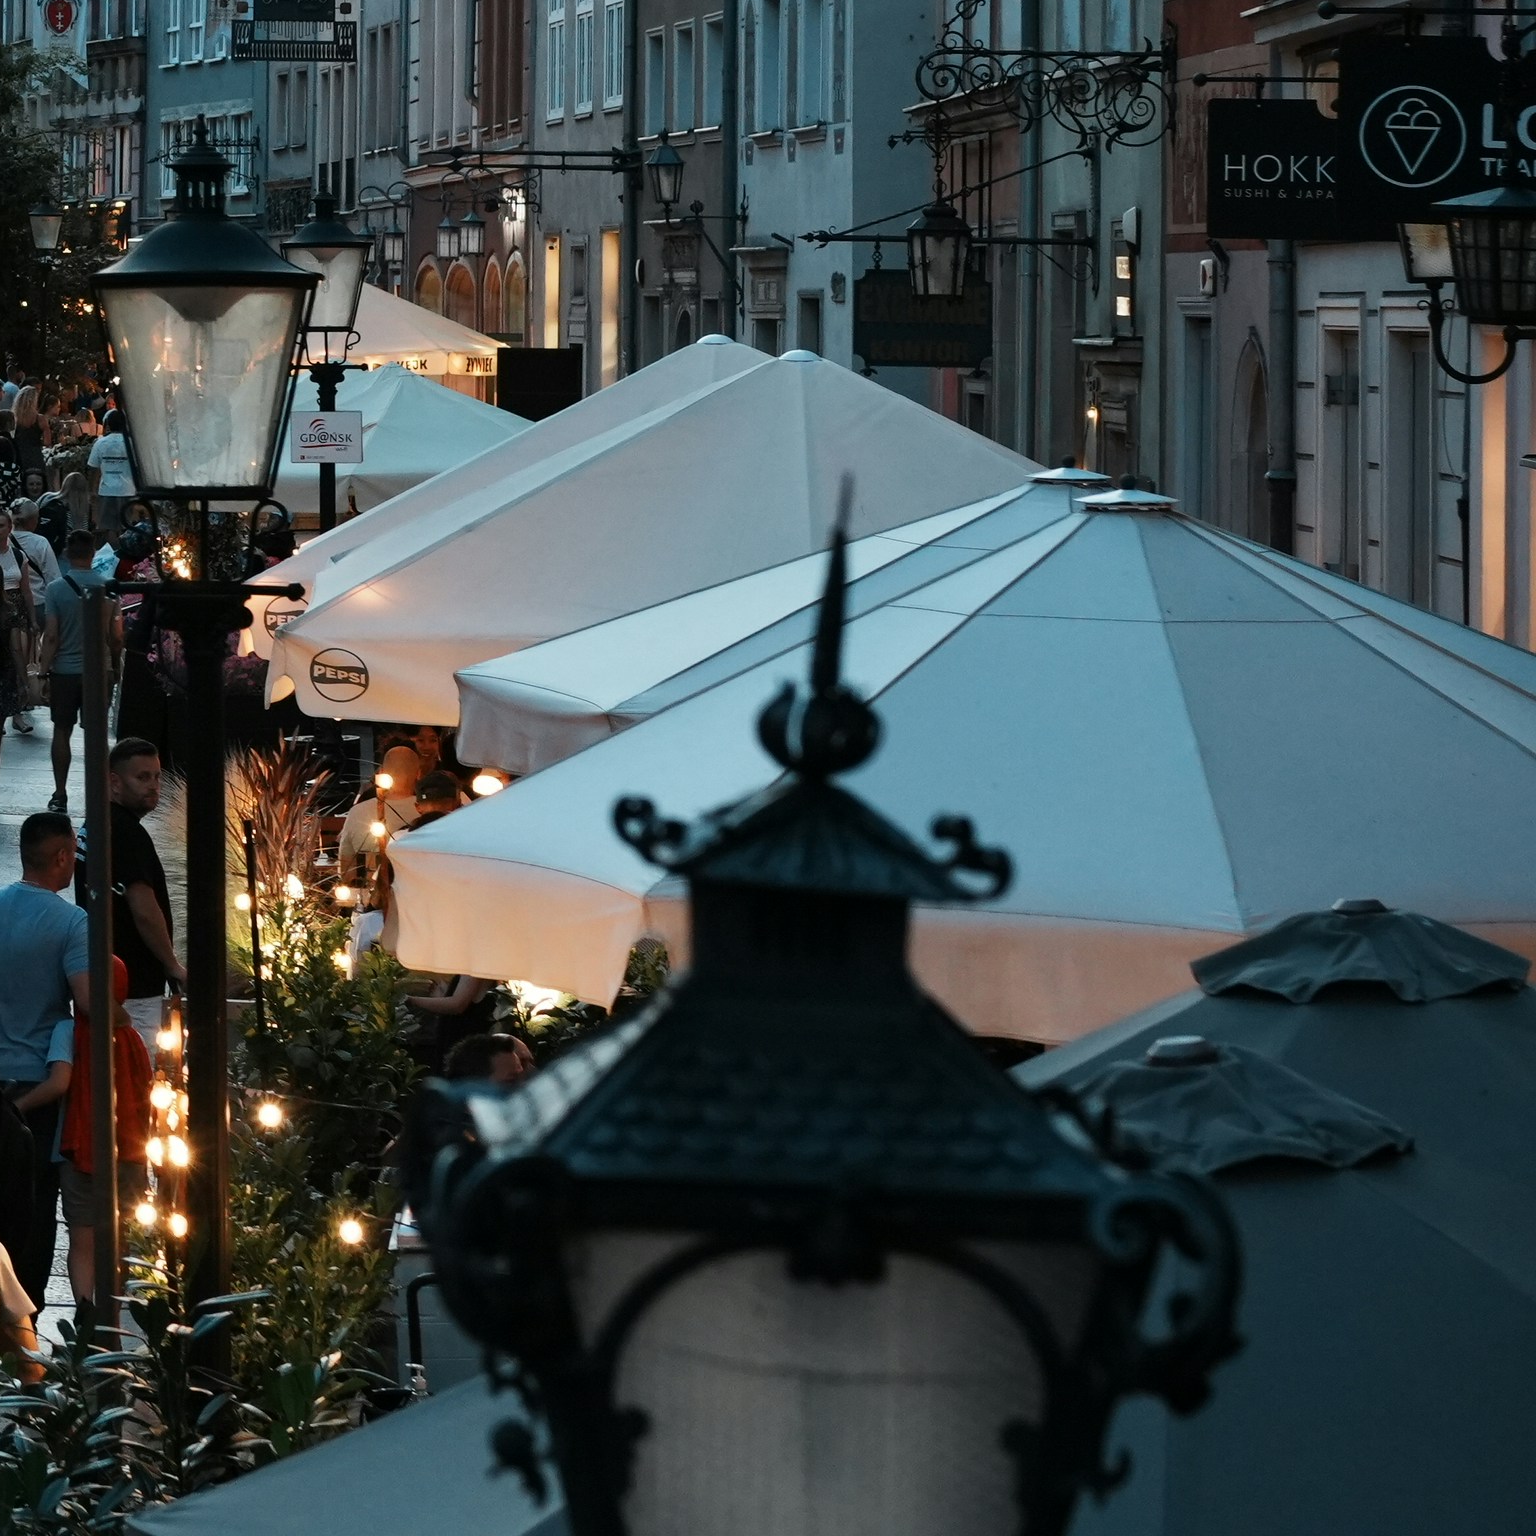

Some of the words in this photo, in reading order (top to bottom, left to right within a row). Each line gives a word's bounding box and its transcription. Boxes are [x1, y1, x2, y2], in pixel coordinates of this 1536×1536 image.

[1224, 154, 1336, 184] HOKK
[1224, 188, 1269, 198] SUSHI
[1278, 189, 1288, 199] &
[1295, 190, 1335, 199] JAPA
[313, 664, 366, 685] PEPSI
